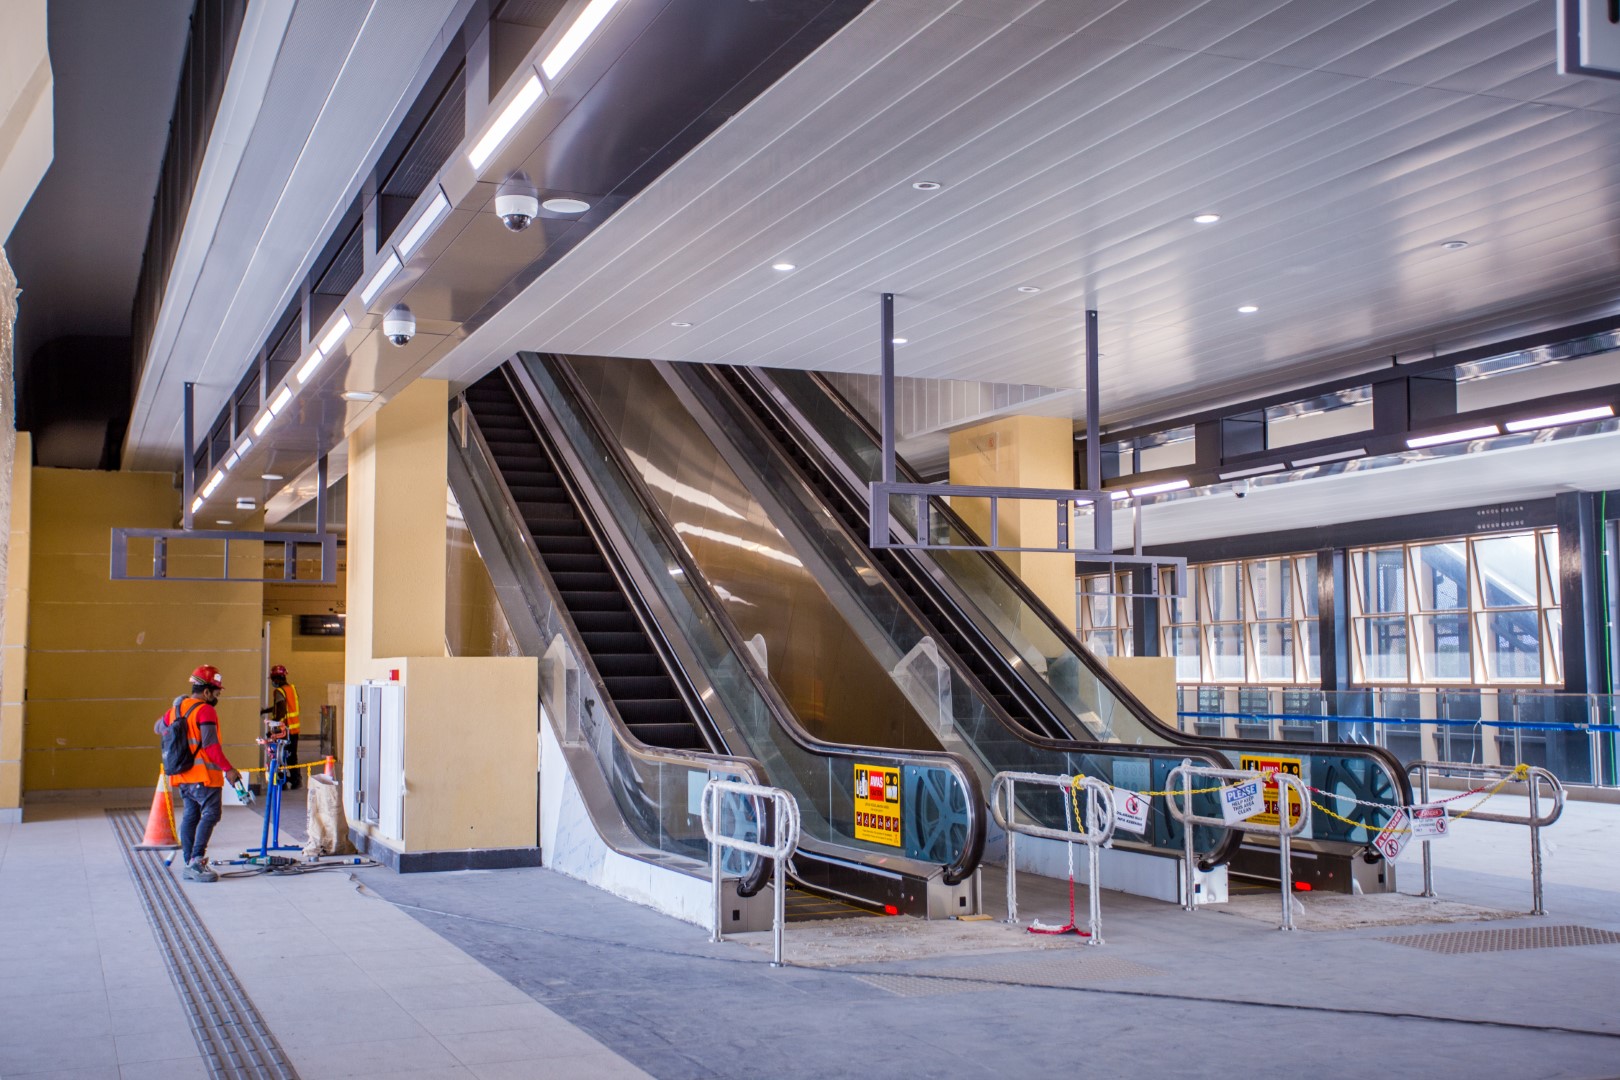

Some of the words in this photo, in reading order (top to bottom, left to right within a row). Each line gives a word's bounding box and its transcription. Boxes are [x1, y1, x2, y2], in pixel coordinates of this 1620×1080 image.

[870, 775, 883, 788] AWAS
[1227, 785, 1256, 801] PLEASE
[1232, 799, 1244, 807] HELP
[1237, 807, 1251, 815] CLEAN
